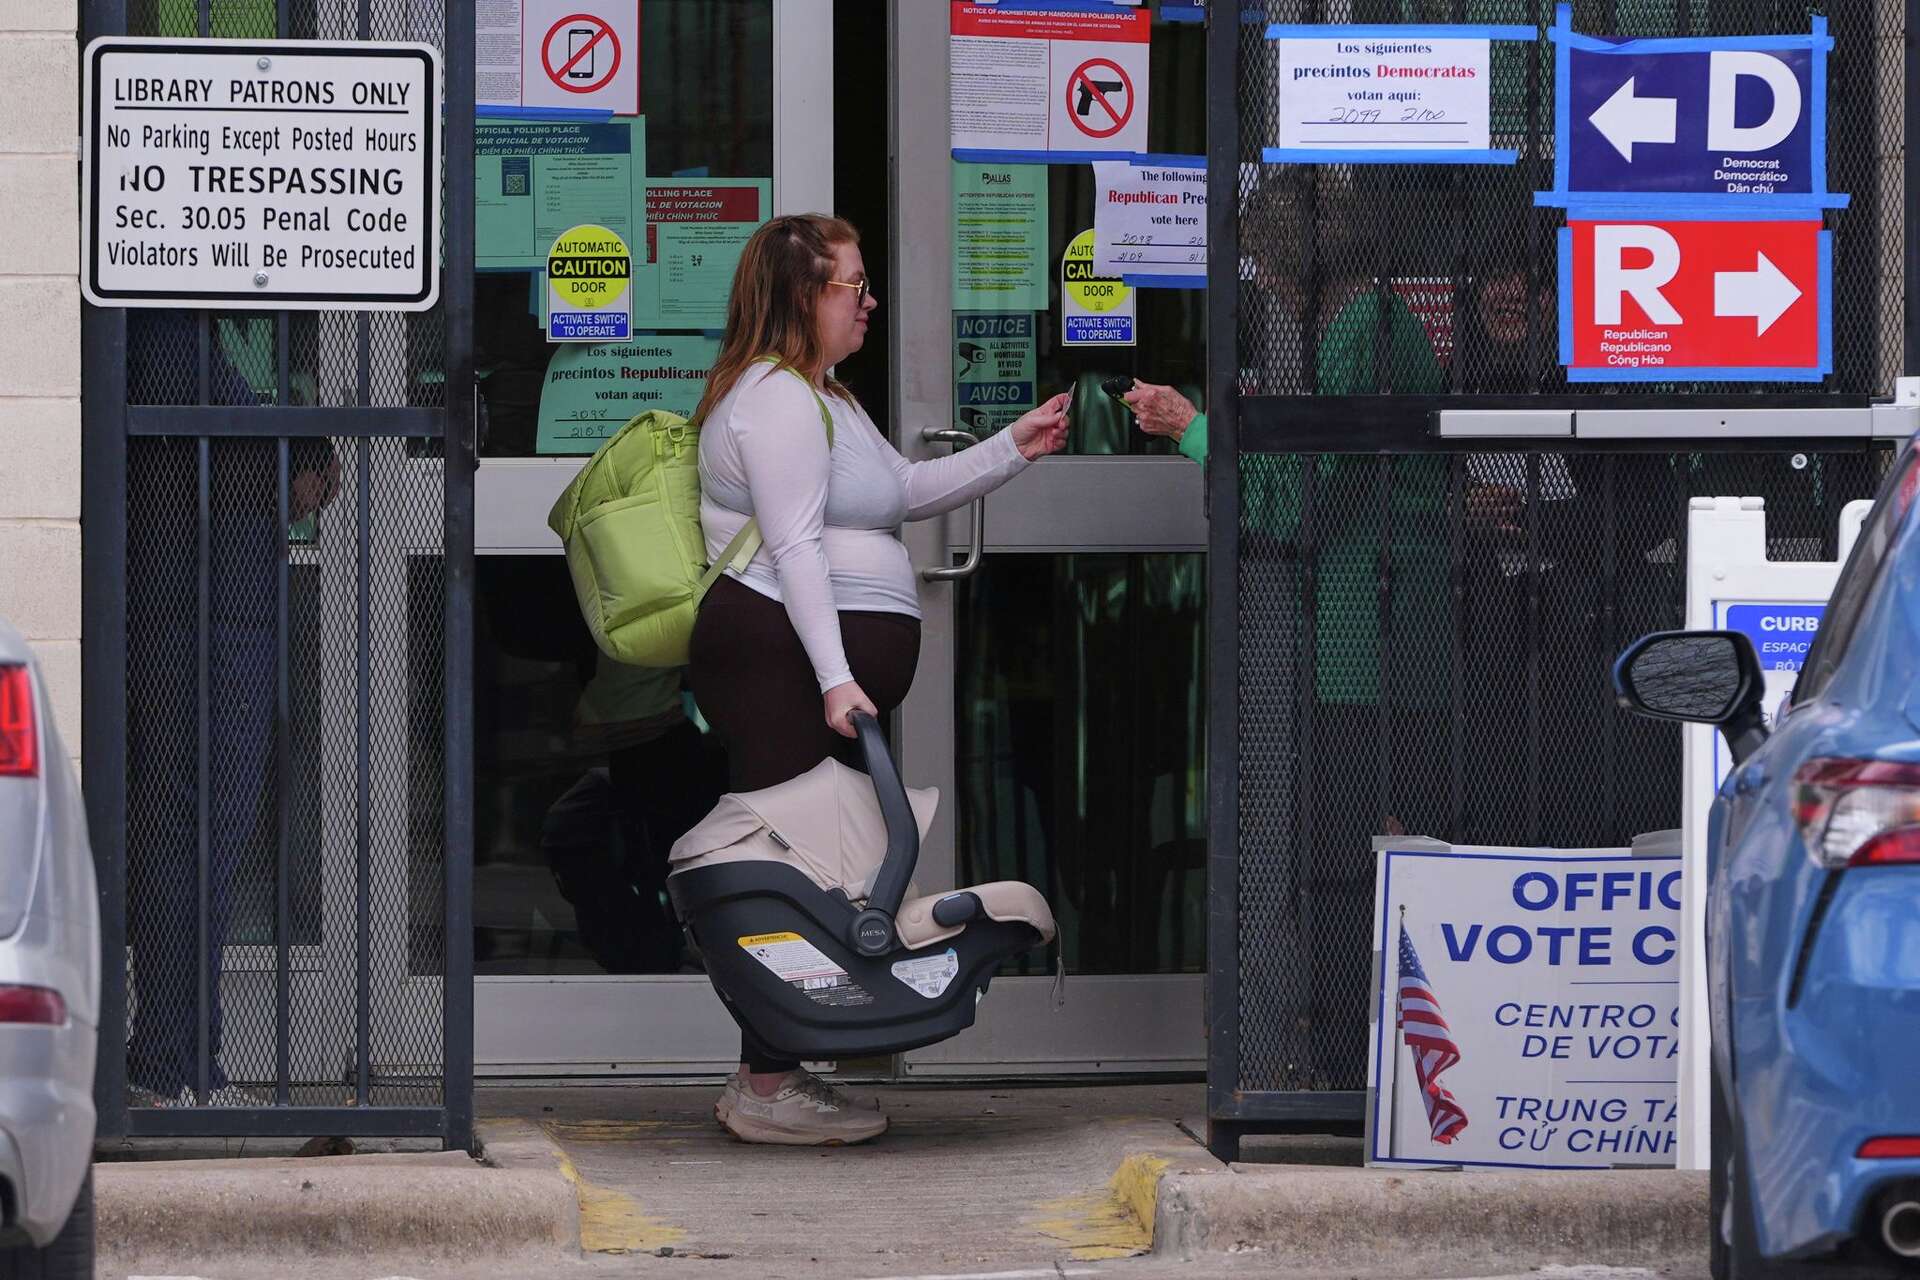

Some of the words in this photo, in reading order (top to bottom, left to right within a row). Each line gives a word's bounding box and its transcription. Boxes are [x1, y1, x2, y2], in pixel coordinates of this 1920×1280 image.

[963, 7, 987, 15] NOTICE
[1048, 11, 1080, 19] HANDGUN
[1088, 12, 1114, 20] POLLING
[1115, 13, 1137, 21] PLACE
[1337, 42, 1360, 54] Los
[1364, 42, 1432, 56] siguientes
[1294, 64, 1371, 80] precintos
[1377, 64, 1476, 79] Democratas
[114, 78, 213, 103] LIBRARY
[229, 80, 335, 105] PATRONS
[352, 82, 410, 106] ONLY
[1347, 90, 1383, 101] votan
[1707, 51, 1802, 152] D
[1329, 108, 1381, 124] 2099
[1401, 107, 1446, 122] 2100
[513, 126, 550, 134] POLLING
[552, 126, 581, 134] PLACE
[107, 125, 131, 149] No
[142, 124, 210, 155] Parking
[222, 127, 281, 156] Except
[292, 127, 354, 152] Posted
[365, 128, 417, 153] Hours
[495, 137, 529, 145] OFICIAL
[1722, 157, 1779, 170] Democrat
[120, 165, 166, 193] NO
[189, 166, 404, 196] TRESPASSING
[1141, 171, 1160, 183] The
[1162, 171, 1207, 184] following
[1714, 169, 1787, 183] Democrático
[659, 201, 671, 209] DE
[1108, 190, 1178, 206] Republican
[115, 205, 166, 230] Sec.
[181, 206, 247, 231] 30.05
[263, 206, 330, 232] Penal
[347, 208, 408, 233] Code
[1151, 216, 1172, 226] vote
[1175, 215, 1199, 226] here
[555, 241, 622, 254] AUTOMATIC
[107, 241, 199, 267] Violators
[211, 242, 250, 268] Will
[263, 243, 288, 269] Be
[301, 244, 416, 271] Prosecuted
[551, 260, 626, 277] CAUTION
[1594, 224, 1684, 325] R
[571, 281, 607, 294] DOOR
[1083, 285, 1114, 297] DOOR
[552, 313, 594, 326] ACTIVATE
[594, 313, 626, 325] SWITCH
[961, 318, 1026, 335] NOTICE
[1067, 318, 1102, 328] ACTIVATE
[1103, 318, 1131, 328] SWITCH
[563, 325, 575, 337] TO
[576, 325, 616, 337] OPERATE
[1076, 330, 1088, 340] TO
[1088, 330, 1122, 340] OPERATE
[1604, 329, 1668, 341] Republican
[587, 346, 607, 358] Los
[611, 346, 673, 359] siguientes
[989, 341, 1000, 351] ALL
[1601, 341, 1672, 354] Republicano
[1608, 354, 1639, 367] Cộng
[1642, 354, 1664, 365] Hòa
[551, 366, 615, 383] precintos
[595, 390, 628, 400] votan
[970, 385, 1020, 401] AVISO
[1760, 616, 1819, 631] CURB
[860, 928, 887, 938] MESA
[1440, 923, 1612, 966] VOTE
[1495, 1002, 1657, 1029] CENTRO
[1521, 1035, 1573, 1059] DE
[1495, 1096, 1627, 1122] TRUNG
